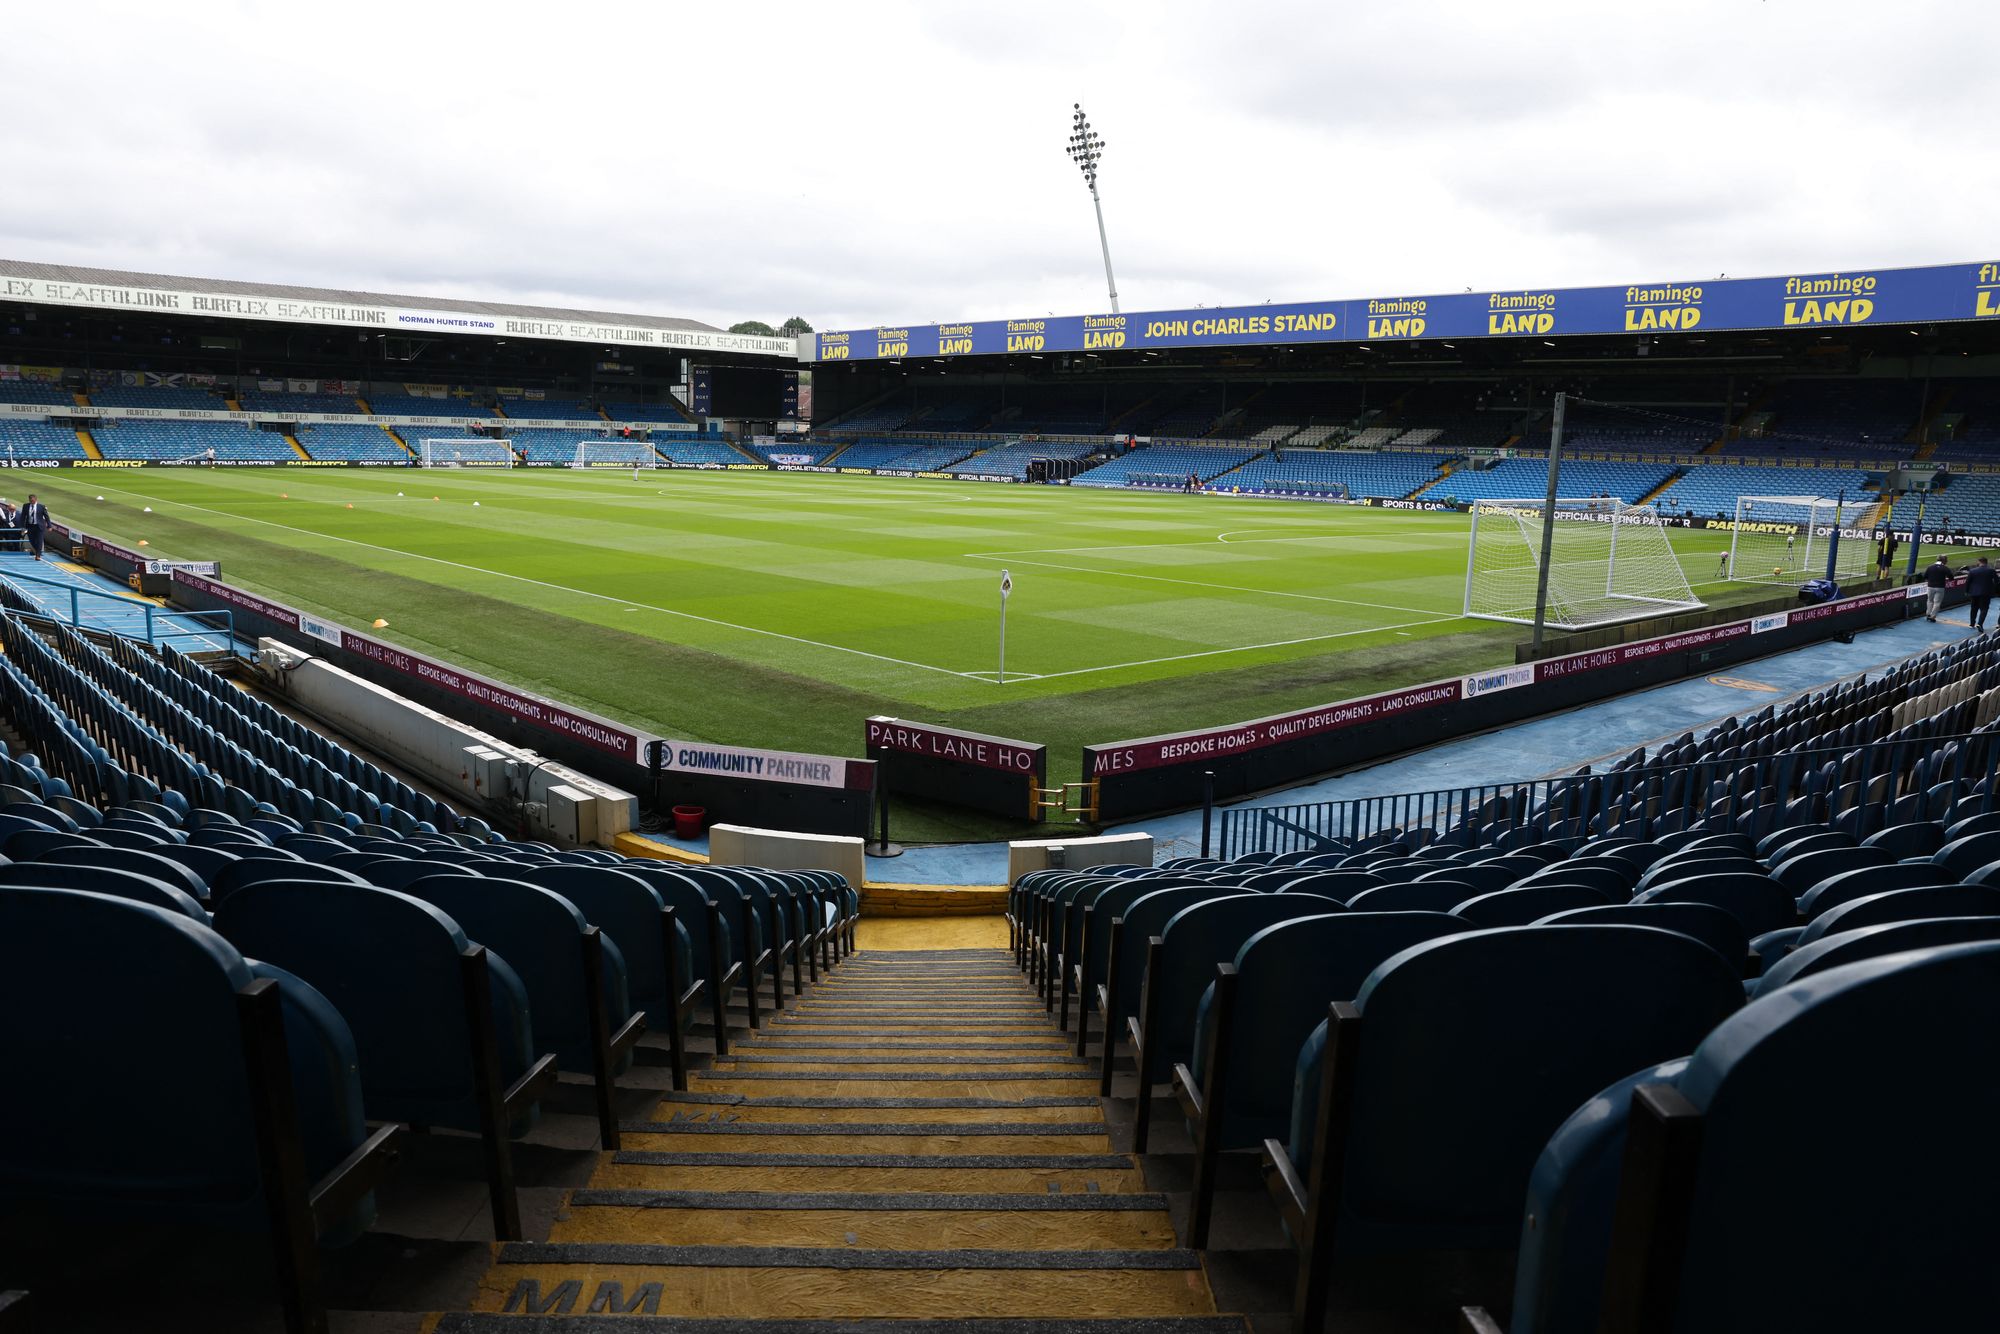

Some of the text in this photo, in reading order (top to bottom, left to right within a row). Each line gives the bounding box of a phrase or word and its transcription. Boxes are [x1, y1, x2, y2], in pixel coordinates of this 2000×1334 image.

[1979, 264, 2000, 283] fl
[1625, 282, 1702, 304] flamingo
[1785, 273, 1876, 297] flamingo
[0, 280, 386, 324] EX SCAFFOLDING BURFLEX SCAFFOLDING
[1369, 297, 1427, 317] flamingo
[1489, 291, 1555, 311] flamingo
[1625, 307, 1701, 331] LAND
[1784, 298, 1875, 326] LAND
[399, 315, 495, 329] NORMAN HUNTER STAND
[939, 323, 973, 337] flamingo
[1007, 319, 1045, 333] flamingo
[1084, 315, 1126, 330] flamingo
[1144, 312, 1337, 338] JOHN CHARLES STAND
[1368, 317, 1426, 339] LAND
[1489, 312, 1555, 335] LAND
[506, 320, 789, 352] BURFLEX SCAFFOLDING BURFLEX SCAFFOLDING
[822, 332, 849, 344] flamingo
[877, 328, 909, 341] flamingo
[1007, 335, 1045, 352] LAND
[1084, 331, 1126, 349] LAND
[822, 345, 849, 360] LAND
[878, 342, 909, 357] LAND
[939, 339, 973, 354] LAND
[21, 460, 60, 468] CASINO
[73, 460, 148, 468] PARIMATCH
[876, 469, 893, 477] SPORTS
[918, 471, 953, 480] PARIMATCH
[958, 473, 979, 481] OFFICIAL
[1382, 500, 1414, 510] SPORTS
[1416, 502, 1423, 510] &
[1553, 511, 1595, 522] OFFICIAL
[1706, 520, 1798, 535] PARIMATCH
[347, 636, 410, 671] PARK LANE HOMES
[1624, 645, 1645, 658] BESPOKE
[1645, 642, 1661, 654] HOMES
[1664, 639, 1682, 651] QUALITY
[1543, 651, 1617, 678] PARK LANE HOMES
[1477, 669, 1530, 692] COMMUNITY PARTNER
[417, 663, 628, 751] BESPOKE HOMES QUALITY DEVELOPMENTS LAND CONSULTANCY
[1094, 685, 1456, 773] MES BESPOKE HOMES QUALITY DEVELOPMENTS LAND CONSULTANCY
[870, 724, 1032, 771] PARK LANE HO
[679, 748, 832, 782] COMMUNITY PARTNER
[502, 1278, 665, 1315] MM
